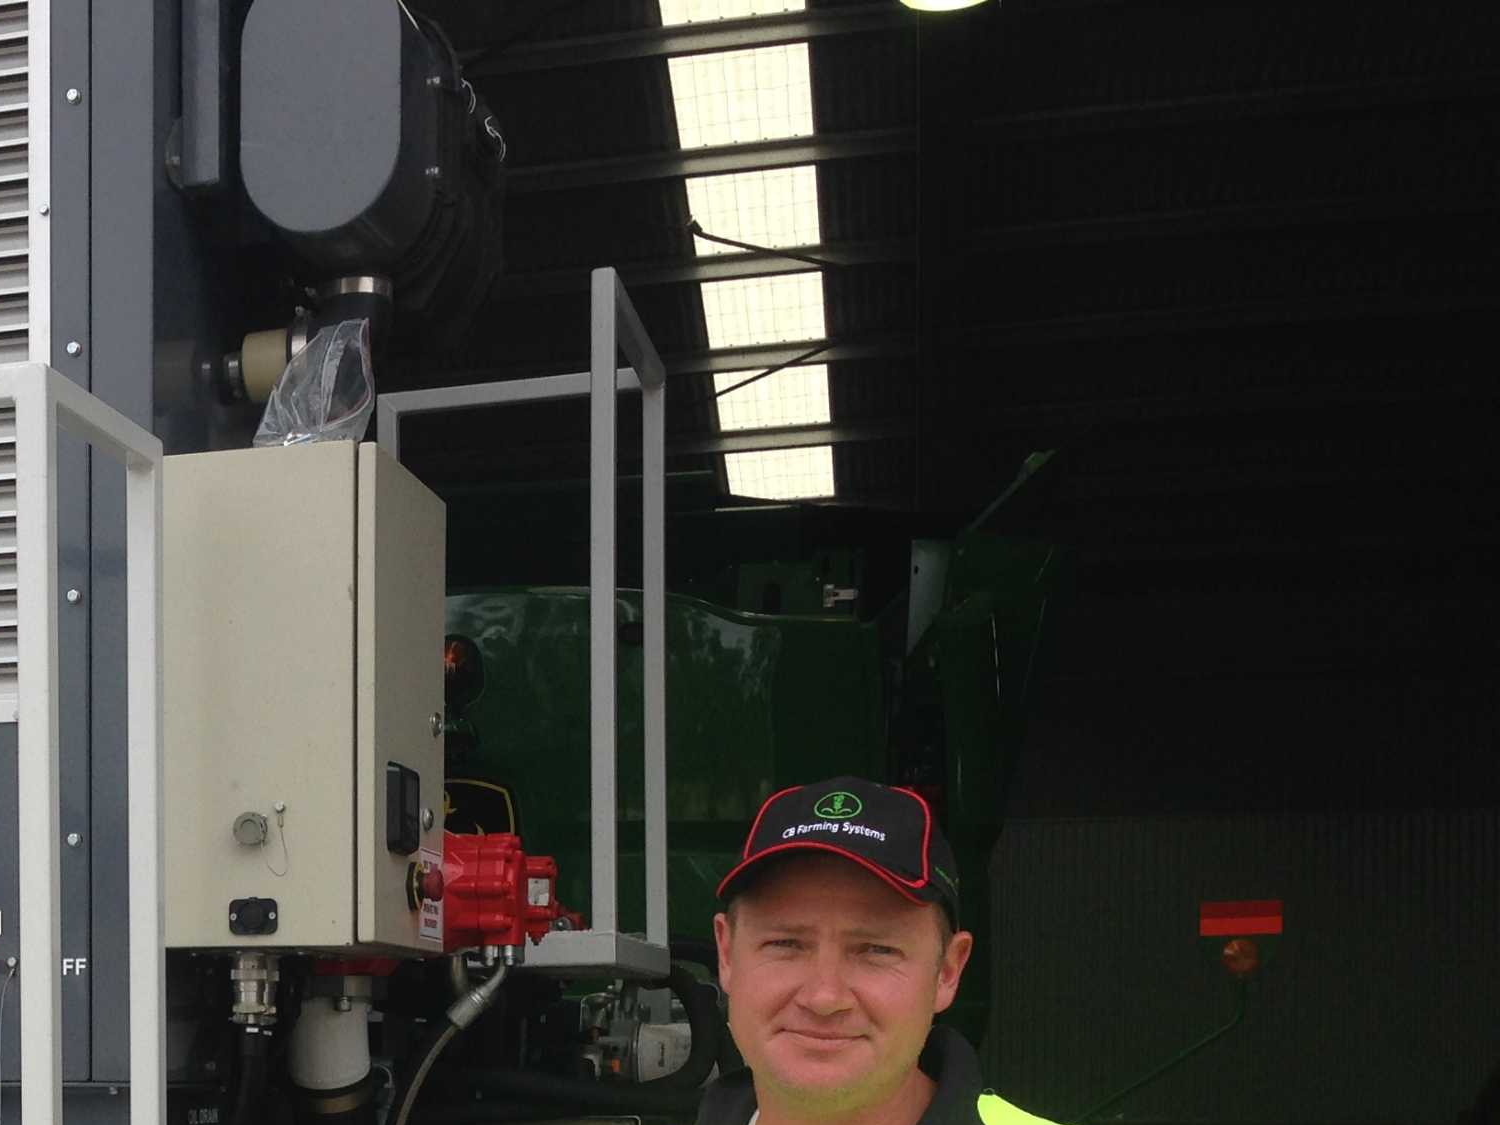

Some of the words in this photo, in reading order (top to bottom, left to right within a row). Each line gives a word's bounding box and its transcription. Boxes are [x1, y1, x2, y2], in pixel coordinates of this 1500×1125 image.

[797, 821, 840, 834] Farming
[842, 821, 886, 841] Systems
[62, 957, 87, 976] FF
